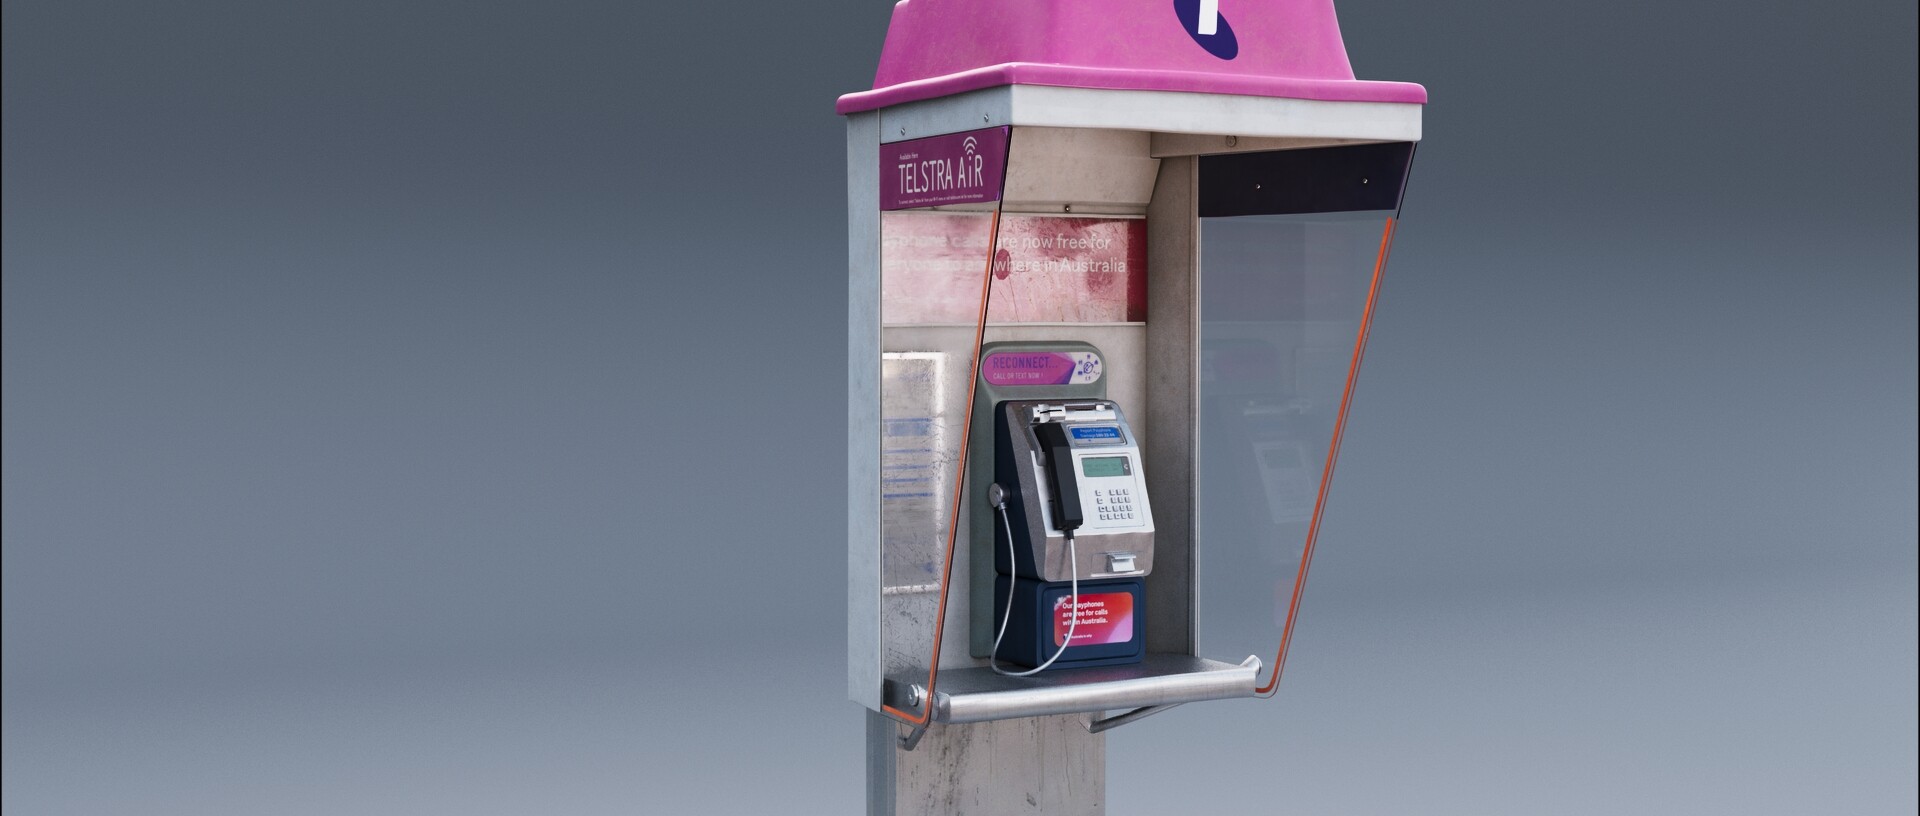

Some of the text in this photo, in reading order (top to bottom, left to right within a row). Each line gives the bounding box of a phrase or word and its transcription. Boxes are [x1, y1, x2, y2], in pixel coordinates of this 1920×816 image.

[898, 157, 954, 194] TELSTRA
[1022, 236, 1053, 249] now
[1056, 232, 1087, 249] free
[1089, 234, 1112, 249] for
[1044, 256, 1057, 271] in
[1059, 256, 1126, 272] Australia
[993, 357, 1058, 369] RECONNECT...
[993, 372, 1006, 380] CALL
[1075, 601, 1104, 610] ayphones
[1095, 608, 1108, 616] calls
[1062, 617, 1108, 626] witin Australia.
